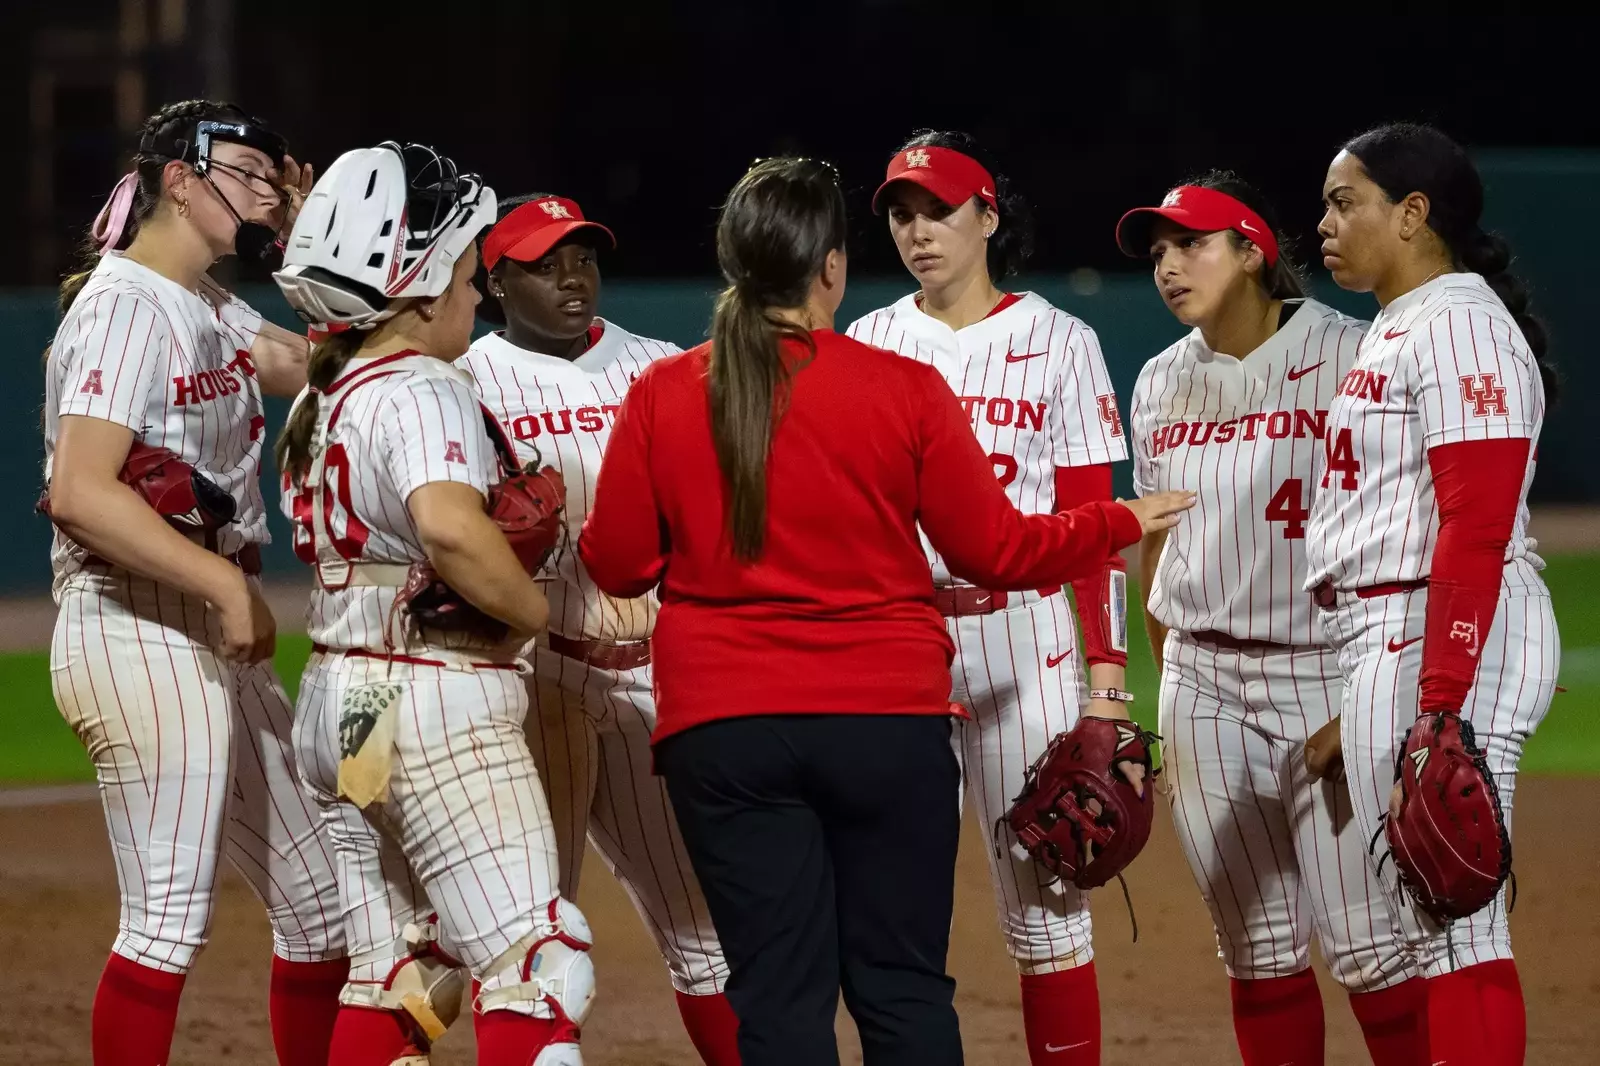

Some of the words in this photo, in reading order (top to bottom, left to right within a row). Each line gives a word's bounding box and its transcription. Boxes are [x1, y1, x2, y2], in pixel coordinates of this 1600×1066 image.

[905, 149, 931, 168] UH
[538, 201, 574, 220] UH
[1458, 373, 1509, 417] UH
[1152, 409, 1329, 458] HOUSTON
[1265, 478, 1309, 539] 4
[1450, 620, 1474, 643] 33
